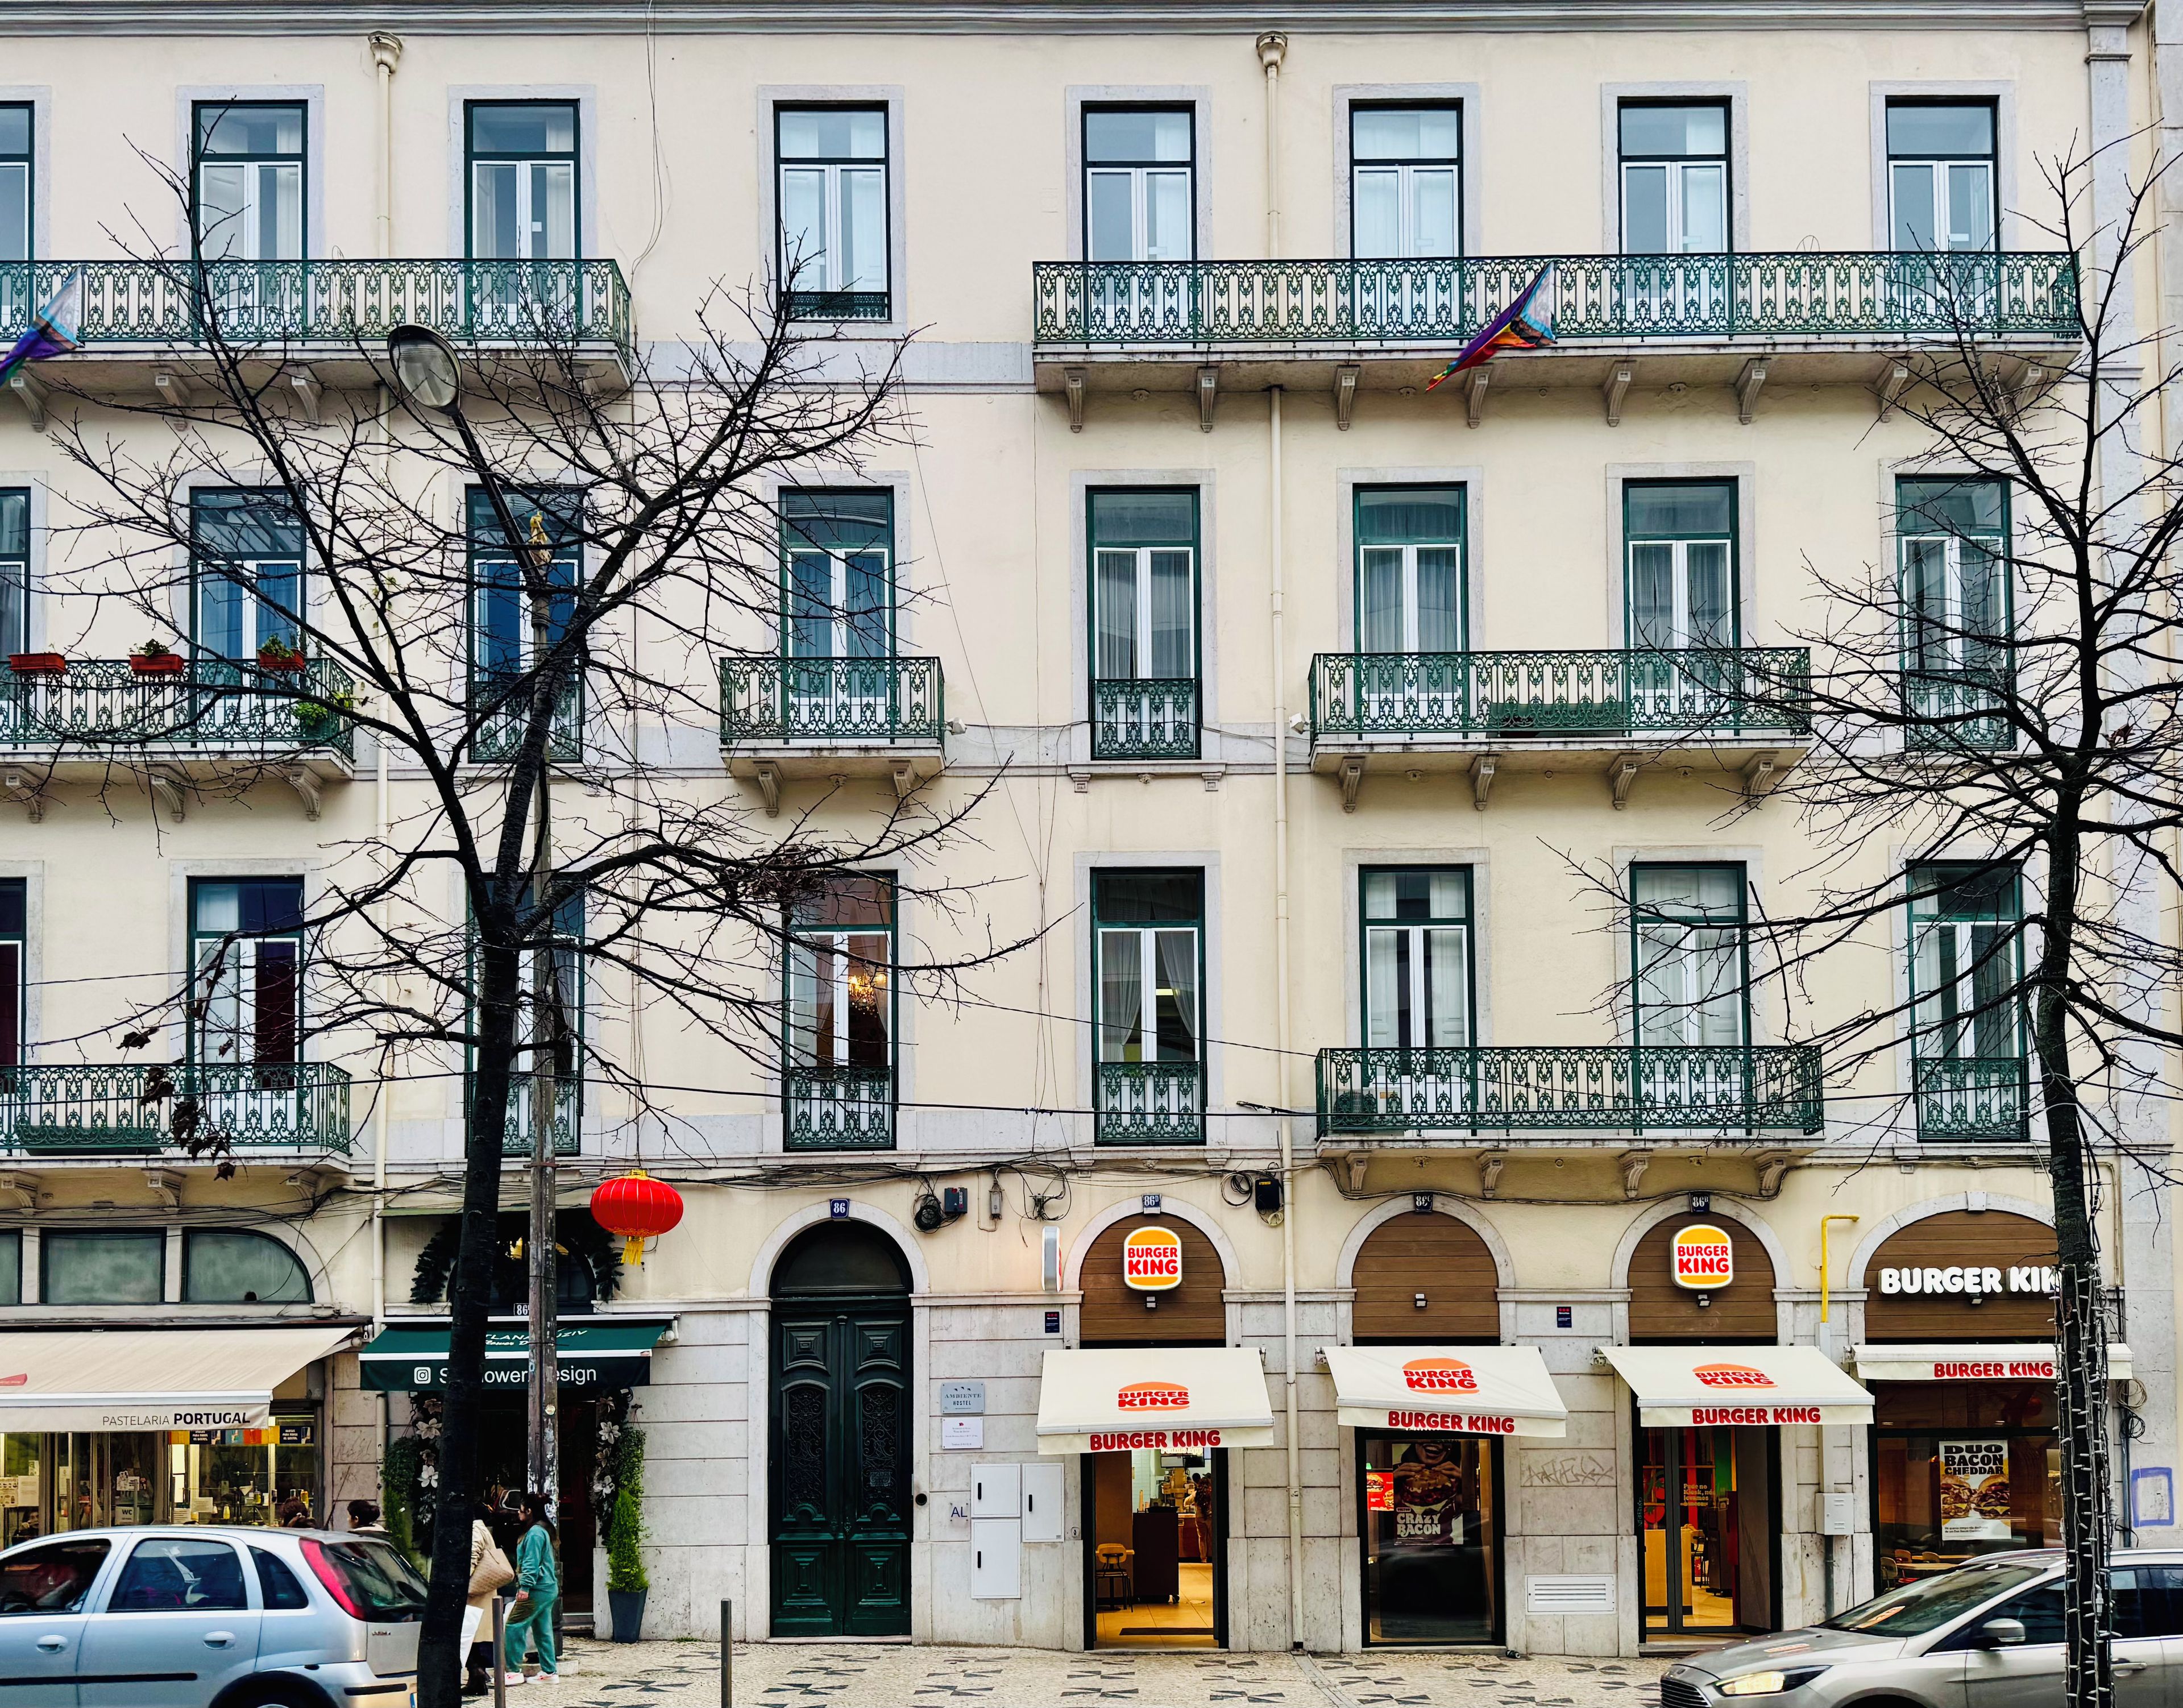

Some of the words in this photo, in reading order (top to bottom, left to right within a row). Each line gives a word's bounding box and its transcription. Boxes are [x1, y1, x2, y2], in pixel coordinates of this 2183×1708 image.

[833, 1202, 846, 1214] 86
[1128, 1247, 1178, 1258] BURGER
[1678, 1245, 1729, 1257] BURGER
[1128, 1259, 1178, 1275] KING
[1678, 1257, 1729, 1274] KING
[1880, 1266, 2003, 1294] BURGER
[2009, 1266, 2063, 1292] KIN
[516, 1304, 530, 1316] 86
[1403, 1369, 1474, 1379] BURGER
[1934, 1362, 2005, 1378] BURGER
[2009, 1362, 2053, 1377] KING
[1405, 1377, 1478, 1389] KING
[1699, 1377, 1775, 1385] KING
[1118, 1397, 1190, 1407] KING
[102, 1415, 170, 1426] PASTELARIA
[173, 1412, 251, 1425] PORTUGAL
[1692, 1408, 1769, 1424] BURGER
[1773, 1407, 1821, 1423] KING
[1388, 1411, 1463, 1431] BURGER
[1468, 1415, 1515, 1433] KING
[1090, 1431, 1168, 1451] BURGER
[1172, 1429, 1221, 1448] KING
[1944, 1444, 2003, 1454] DUO
[1944, 1454, 2003, 1467] BACON
[1944, 1466, 2004, 1475] CHEDDAR
[951, 1506, 968, 1518] AL
[1396, 1512, 1441, 1524] CRAZY
[1397, 1524, 1441, 1537] BACON
